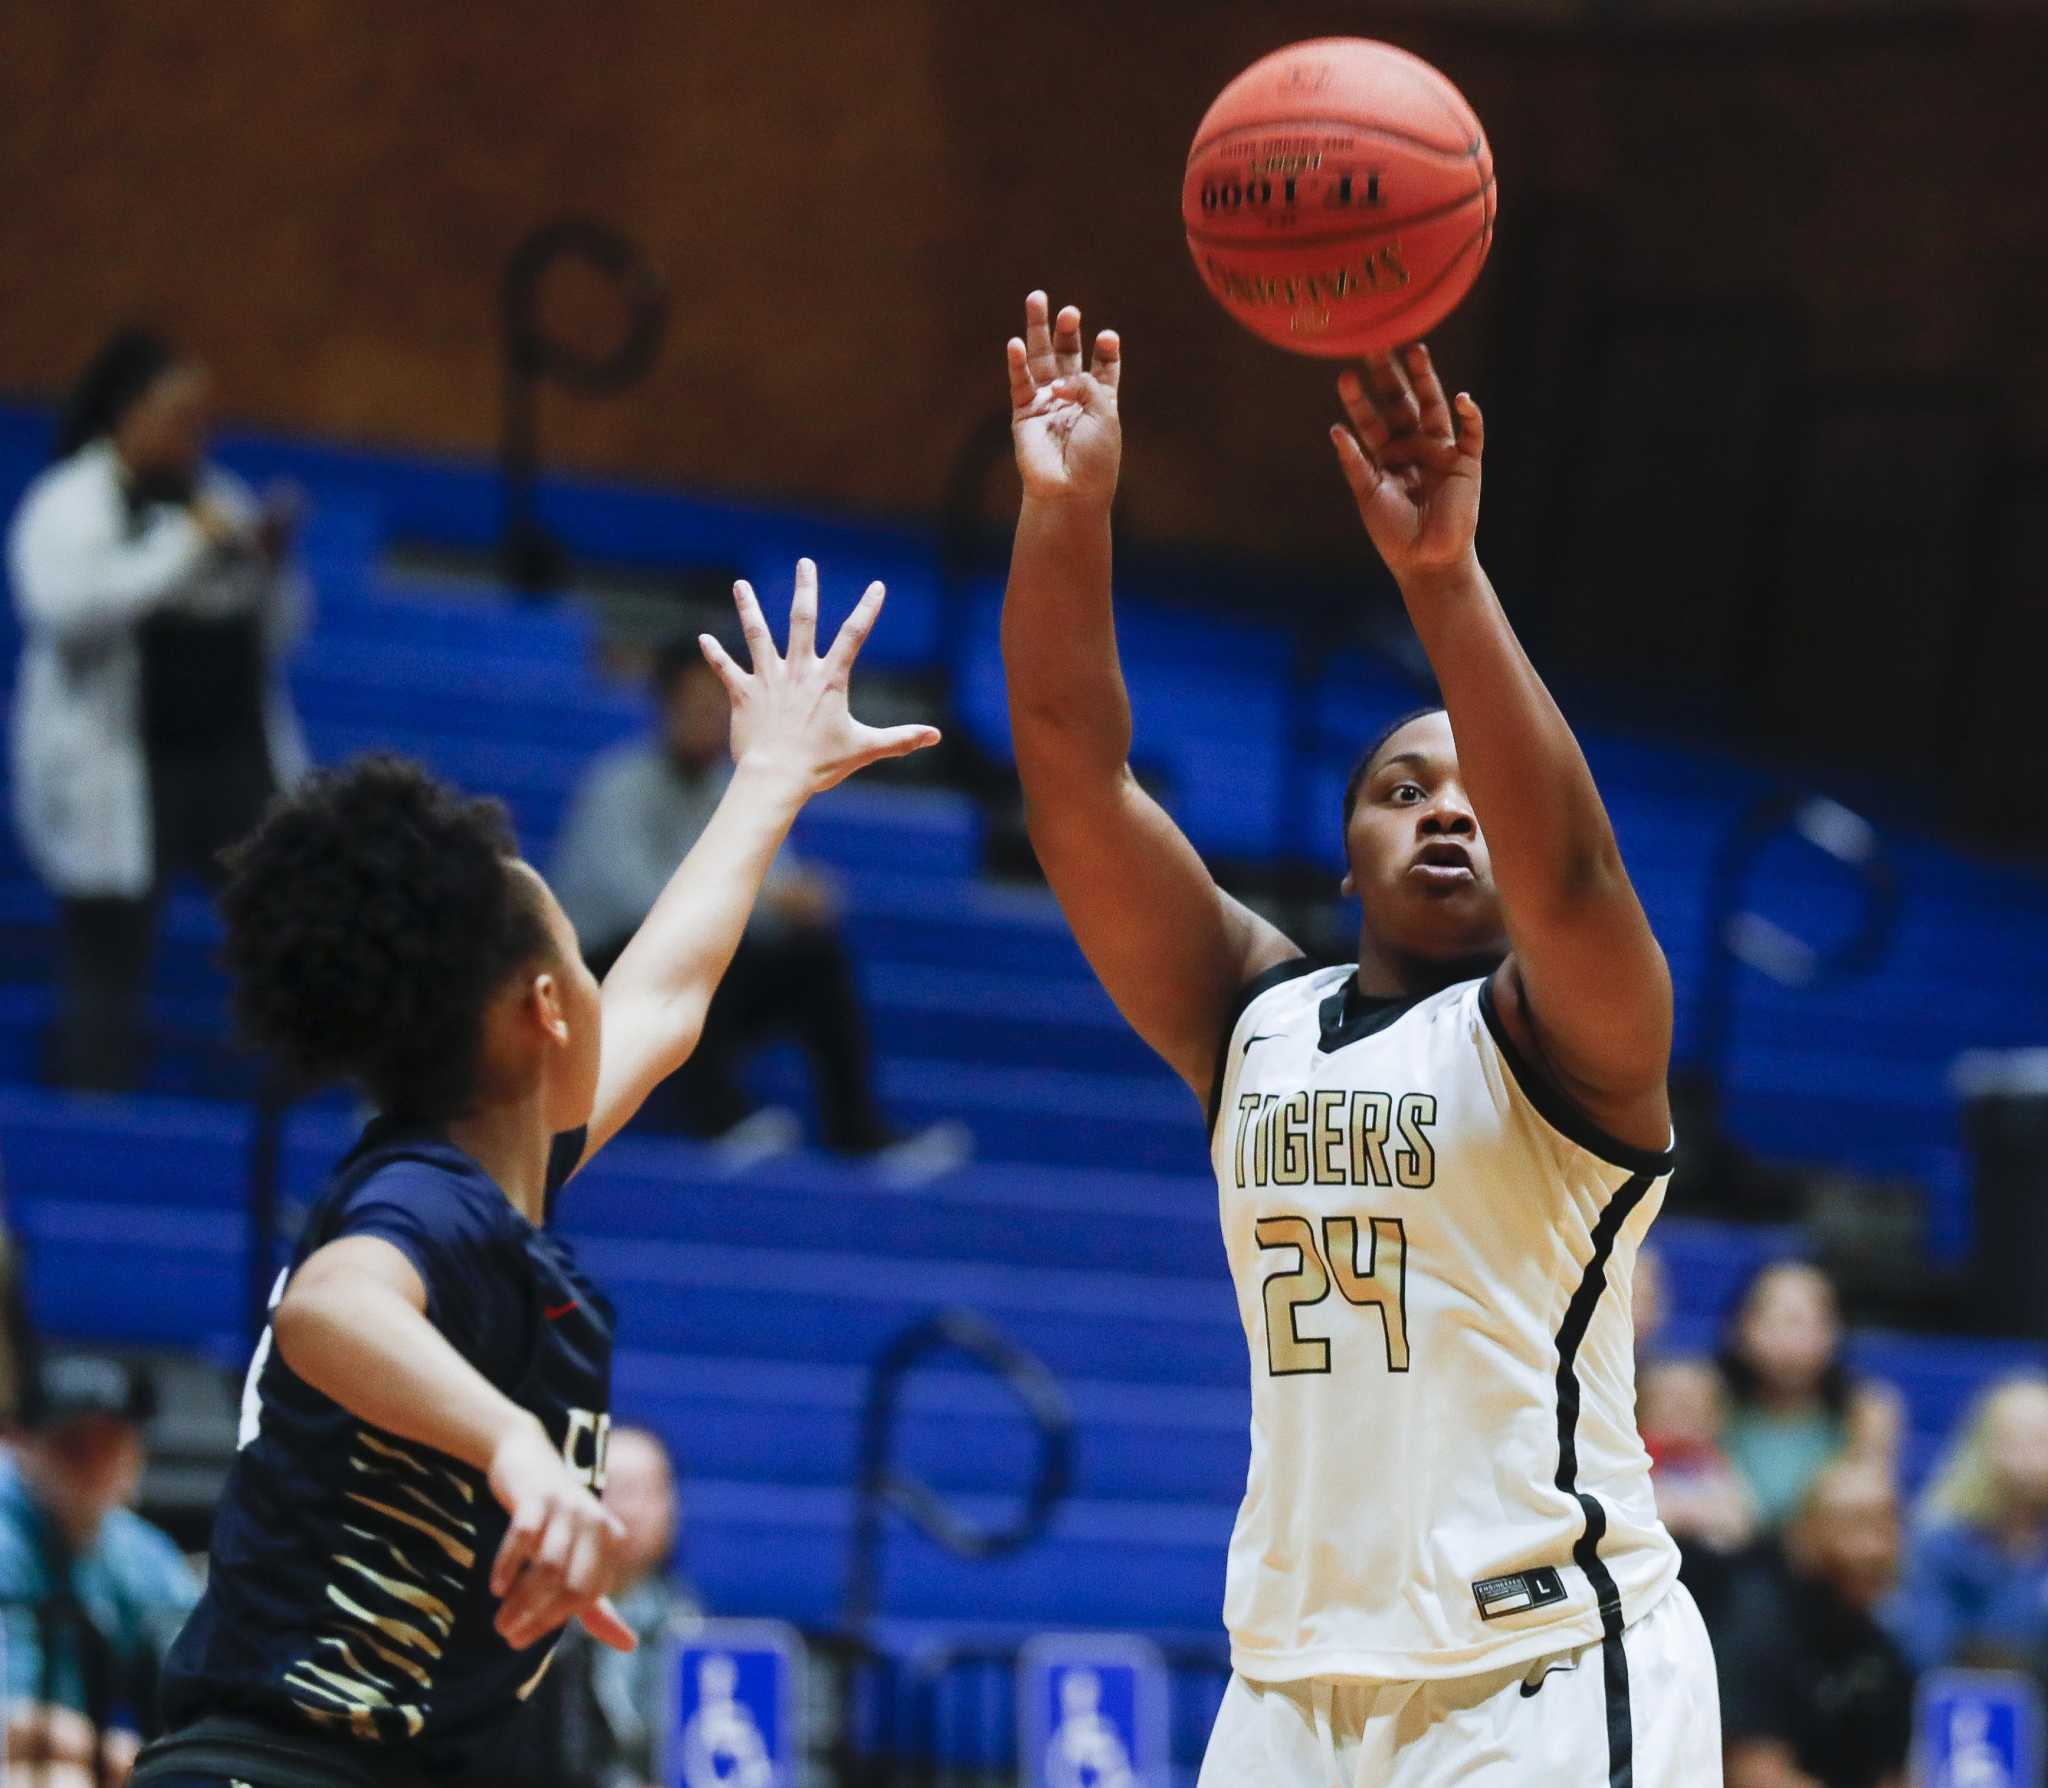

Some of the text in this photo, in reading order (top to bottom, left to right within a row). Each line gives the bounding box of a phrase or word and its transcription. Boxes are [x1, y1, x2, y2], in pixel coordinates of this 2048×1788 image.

[1234, 1090, 1437, 1189] TIGERS
[1255, 1215, 1410, 1377] 24
[1535, 1579, 1551, 1595] L
